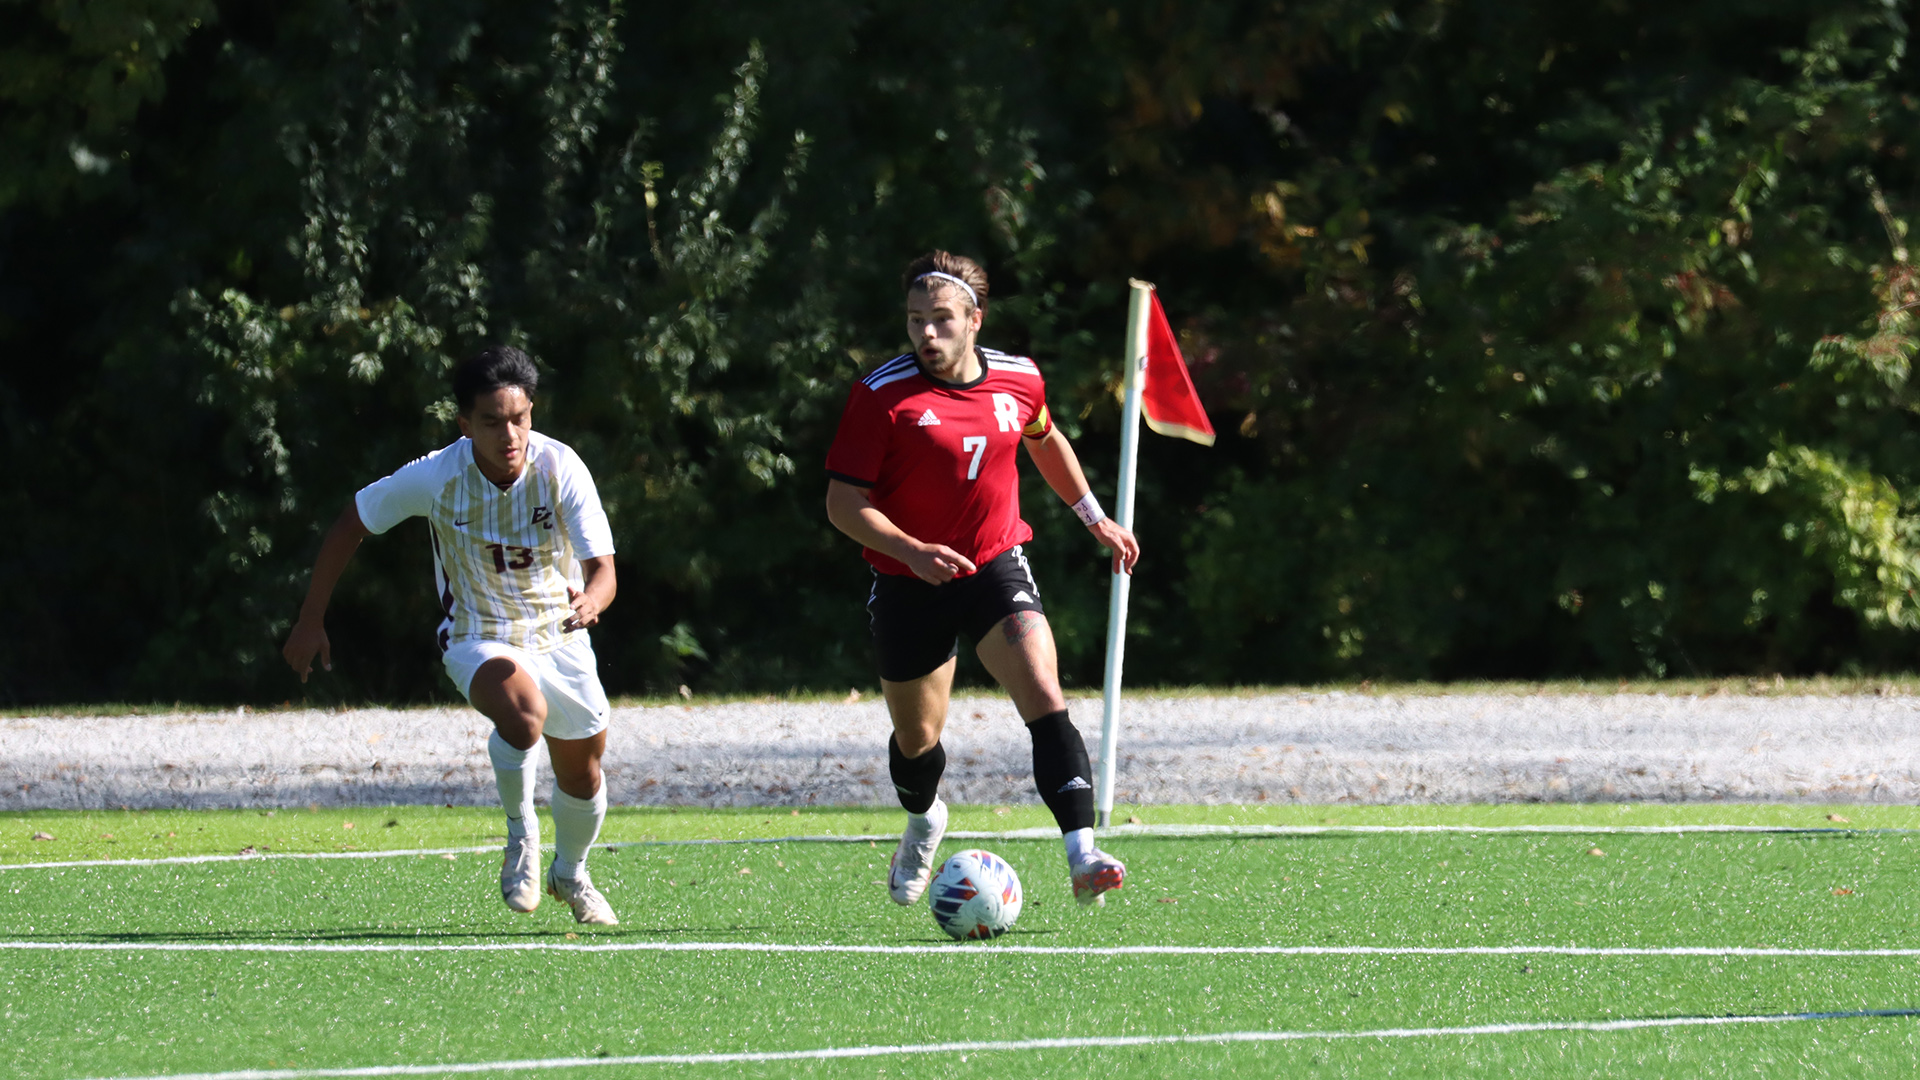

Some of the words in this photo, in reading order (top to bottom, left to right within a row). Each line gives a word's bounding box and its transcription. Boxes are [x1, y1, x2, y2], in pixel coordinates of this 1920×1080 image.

[992, 393, 1021, 432] R
[963, 436, 987, 480] 7
[486, 543, 535, 574] 13
